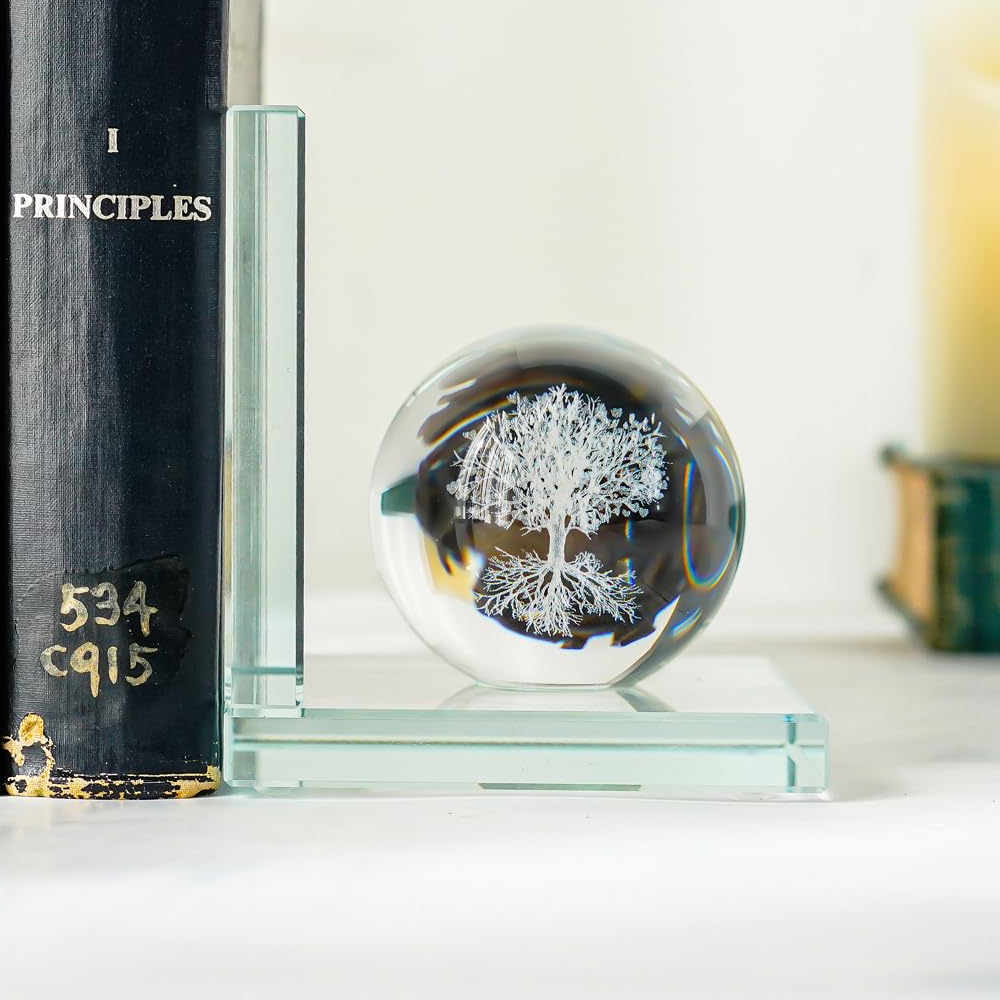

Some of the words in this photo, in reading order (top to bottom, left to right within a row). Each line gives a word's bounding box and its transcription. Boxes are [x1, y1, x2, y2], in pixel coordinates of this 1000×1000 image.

[107, 127, 119, 154] I
[12, 193, 213, 222] PRINCIPLES
[60, 581, 160, 637] 534
[40, 641, 159, 697] C915
